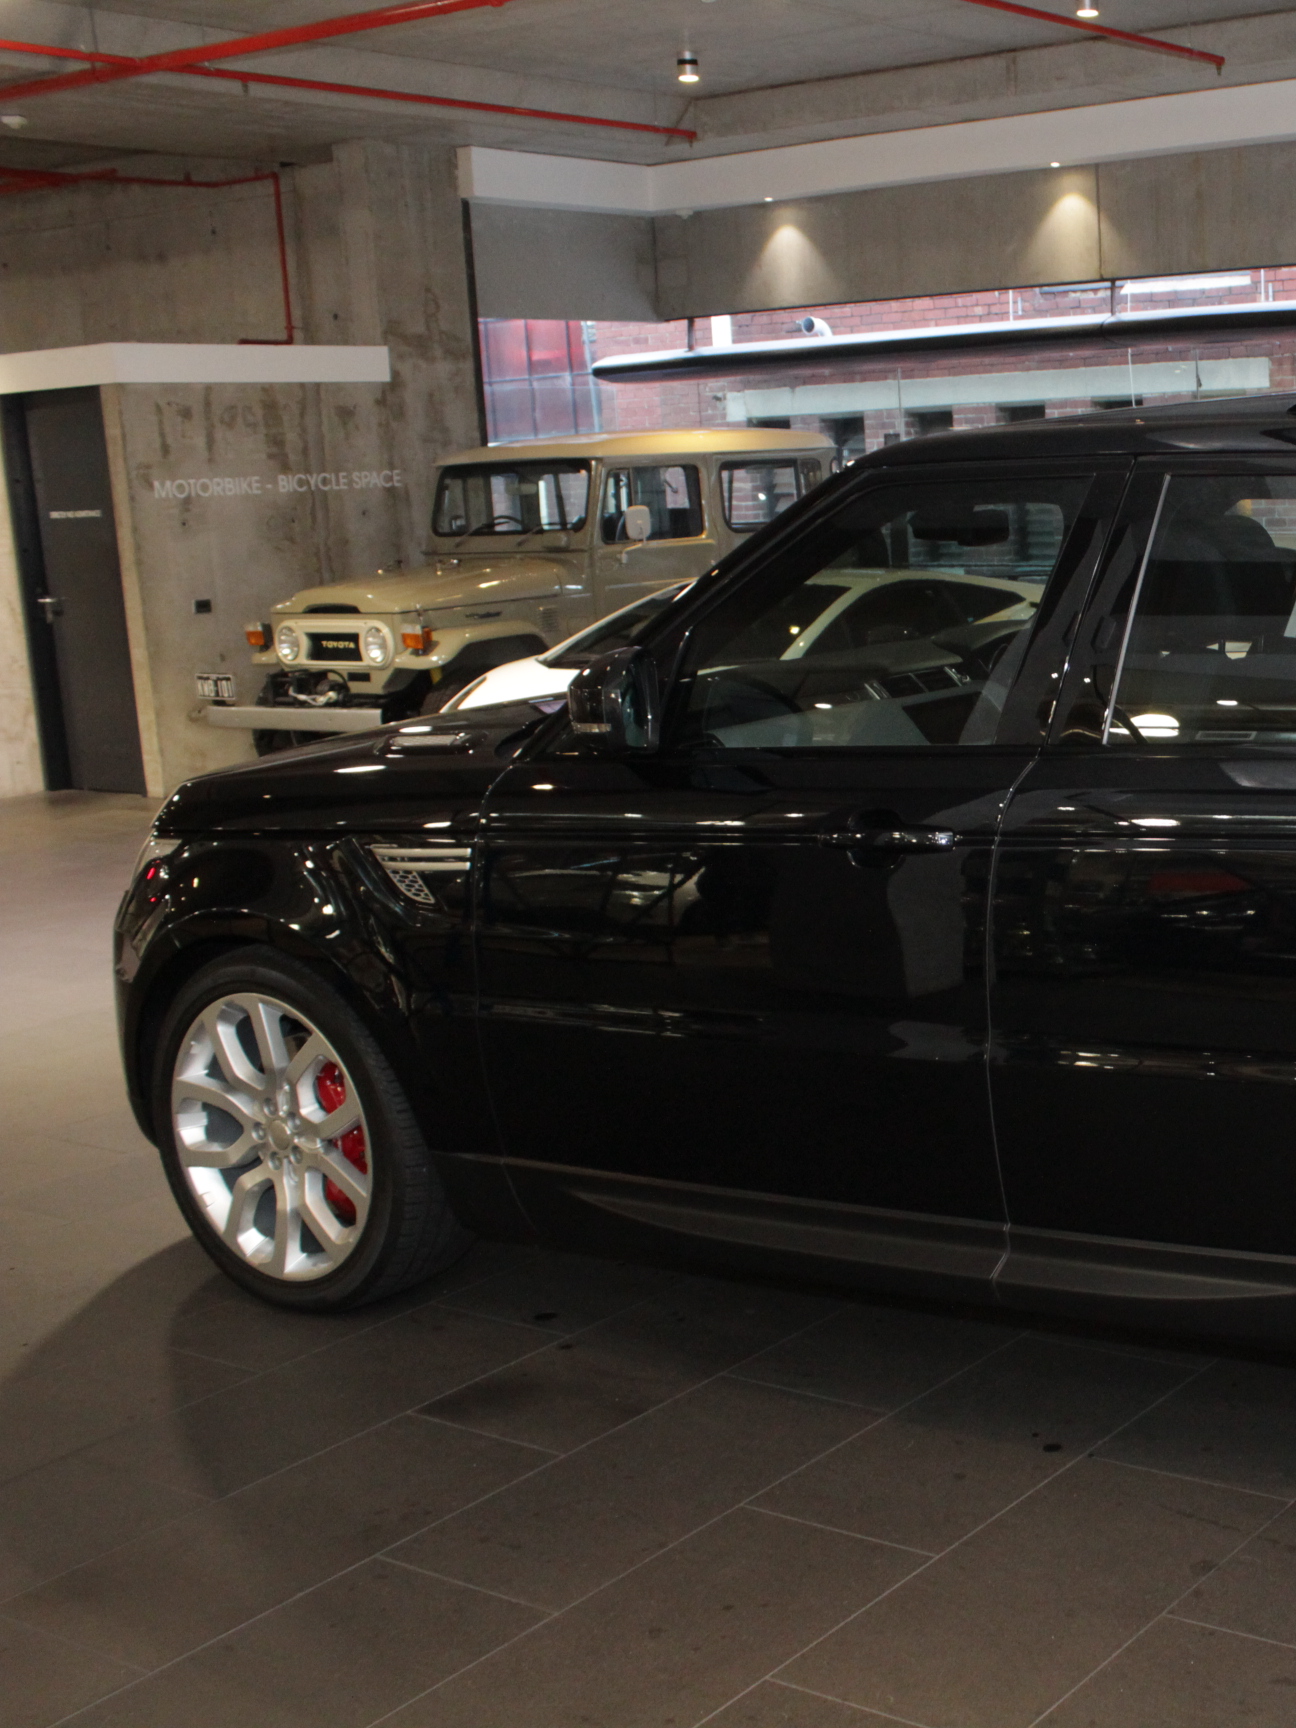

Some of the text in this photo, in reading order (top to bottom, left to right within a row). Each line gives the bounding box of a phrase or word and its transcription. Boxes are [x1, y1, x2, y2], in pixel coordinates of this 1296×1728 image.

[153, 476, 262, 498] MOTORBIKE
[278, 472, 349, 492] BICYCLE
[351, 469, 402, 489] SPACE
[321, 640, 356, 649] TOYOTA
